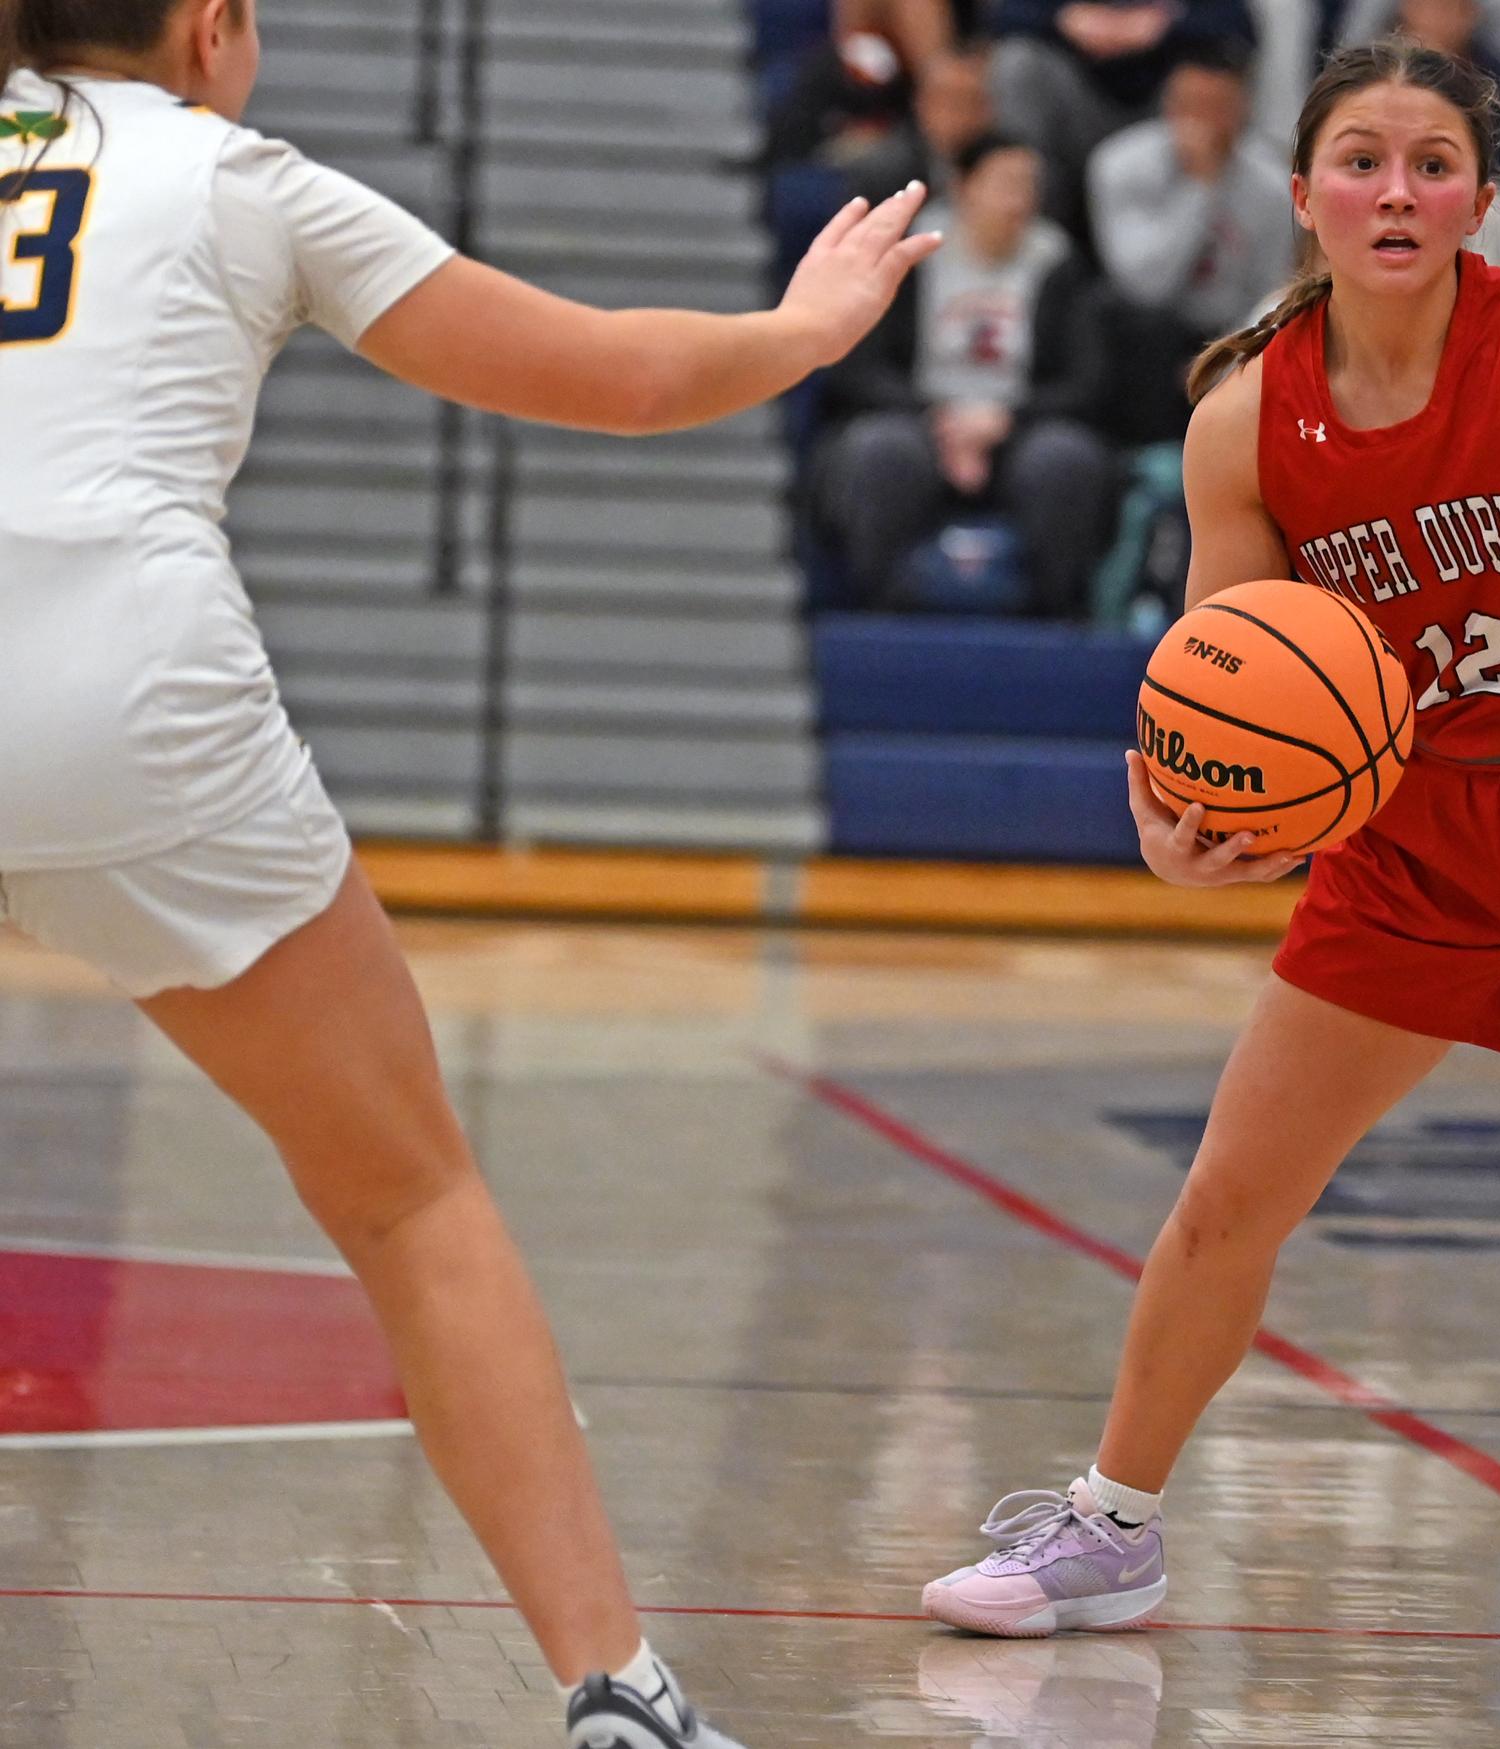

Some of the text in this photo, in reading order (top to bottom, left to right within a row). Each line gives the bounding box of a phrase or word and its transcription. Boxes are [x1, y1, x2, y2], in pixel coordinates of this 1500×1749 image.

[0, 167, 94, 343] 3
[1298, 517, 1420, 604] UPPER
[1192, 640, 1243, 675] NFHS
[1138, 700, 1266, 794] Wilson
